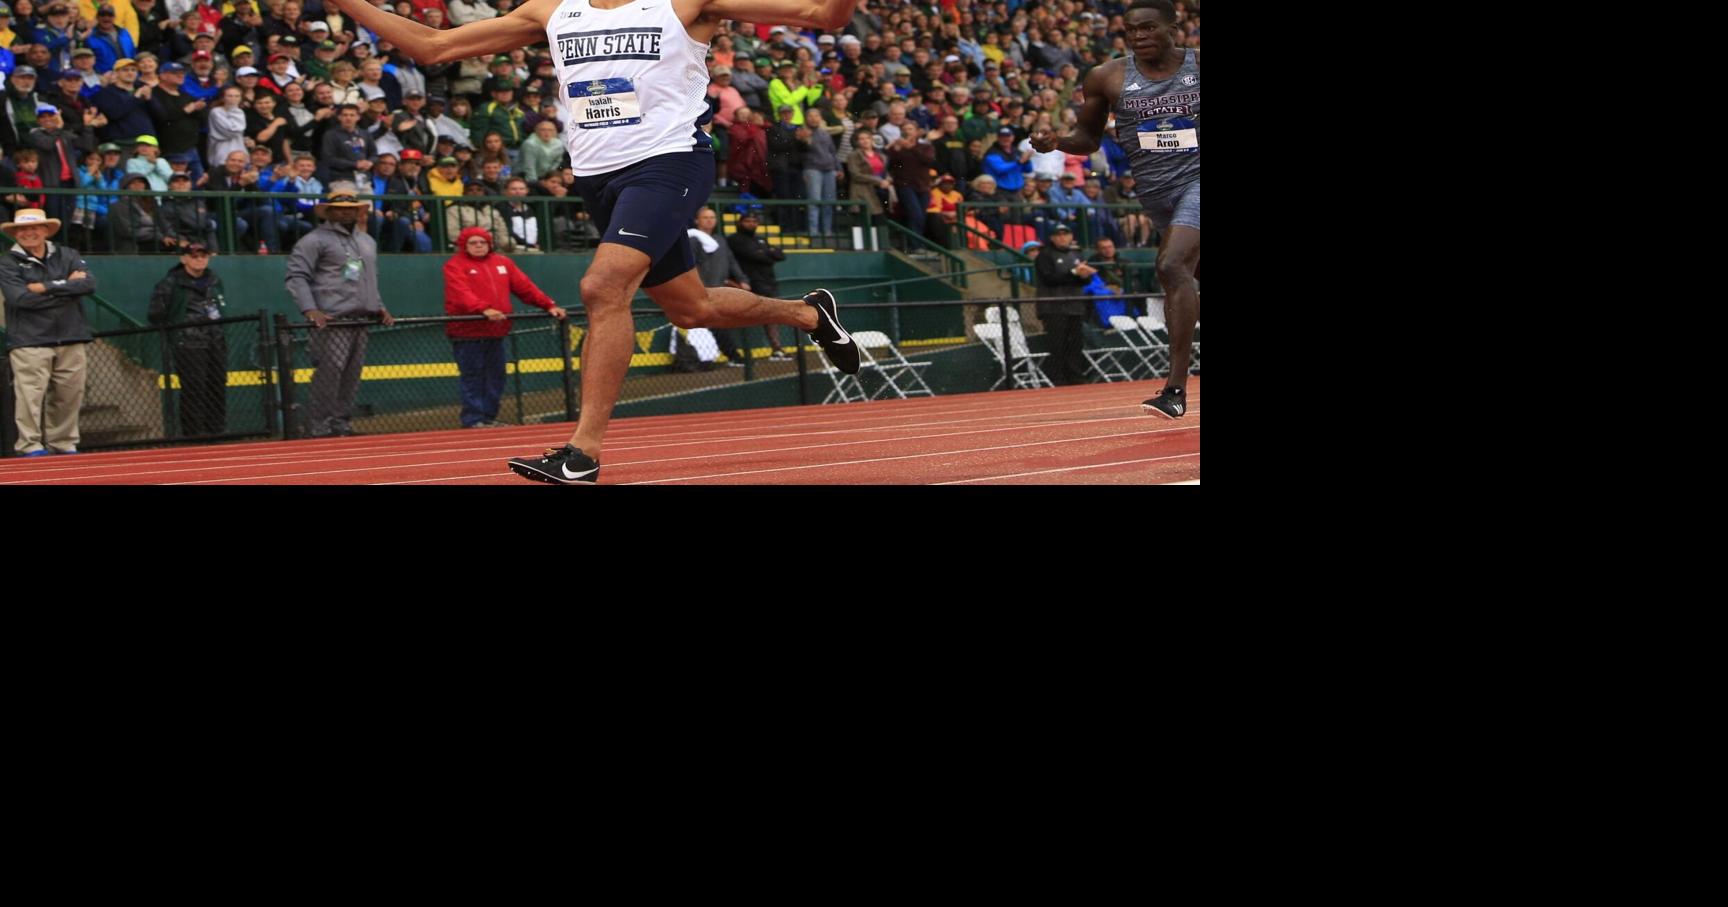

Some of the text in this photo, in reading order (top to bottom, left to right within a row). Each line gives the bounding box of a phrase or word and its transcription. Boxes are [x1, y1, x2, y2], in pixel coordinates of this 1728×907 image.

[558, 34, 661, 60] PENN STATE
[588, 97, 612, 106] Isaiah
[1124, 93, 1200, 109] MISSISSIPP
[586, 106, 620, 119] Harris
[1147, 106, 1184, 115] STATE
[1156, 140, 1179, 148] Arop
